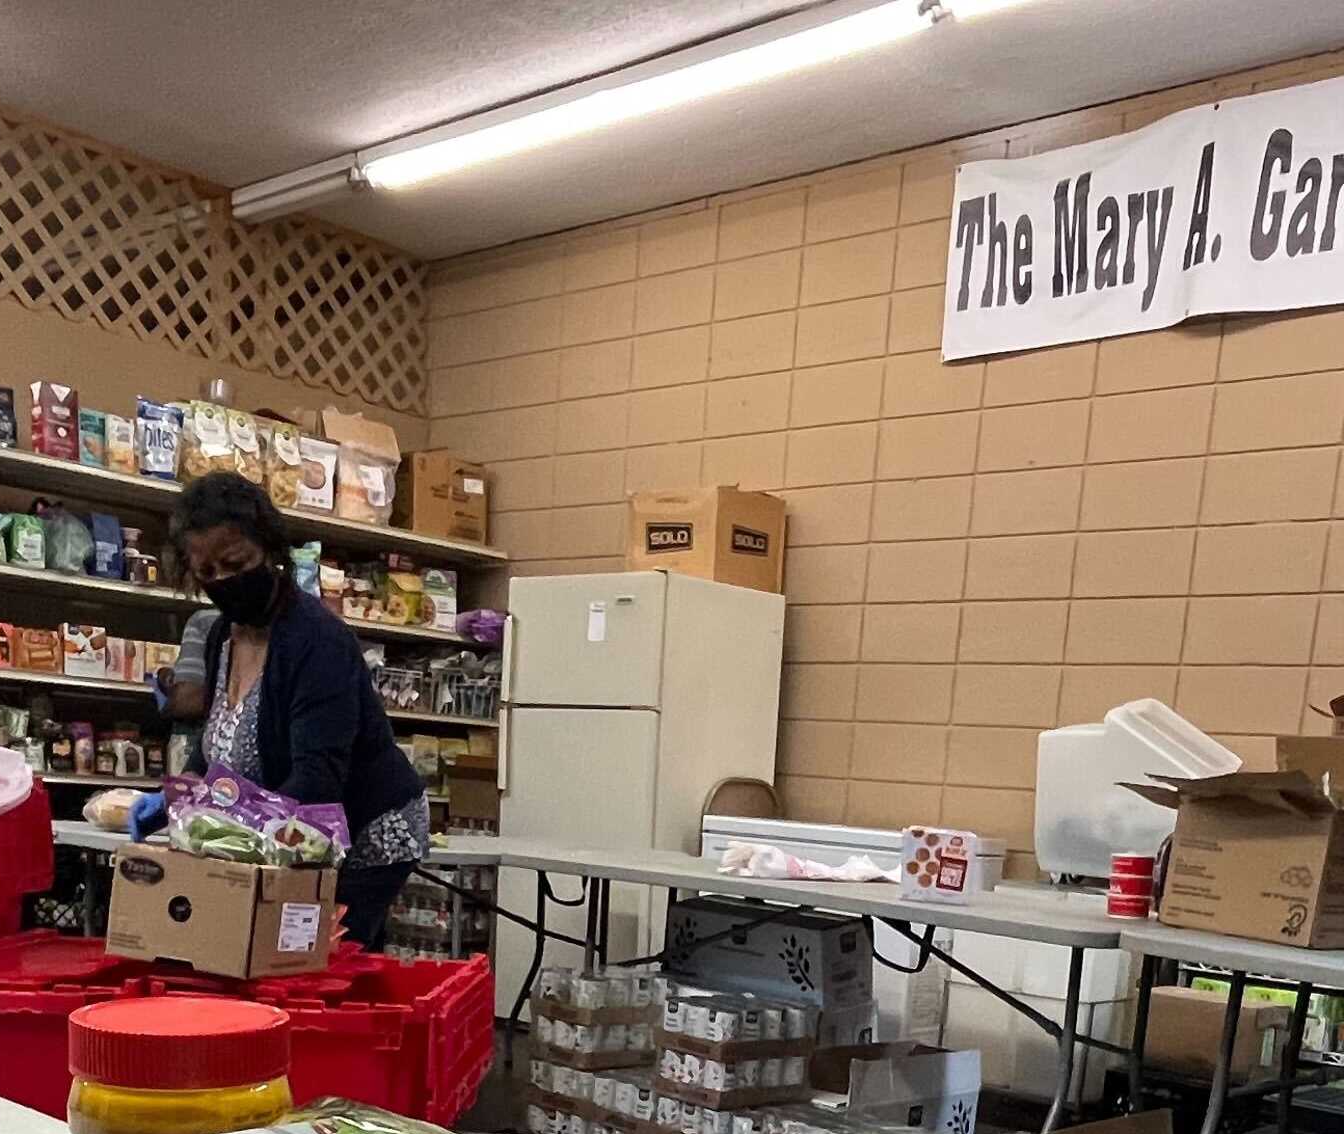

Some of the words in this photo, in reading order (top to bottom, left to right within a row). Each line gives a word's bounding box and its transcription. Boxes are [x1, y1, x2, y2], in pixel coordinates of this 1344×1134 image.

[956, 193, 1033, 312] The
[1051, 172, 1175, 312] Mary
[1182, 142, 1221, 271] A.
[650, 530, 688, 545] SOLO
[735, 533, 766, 549] SOLO
